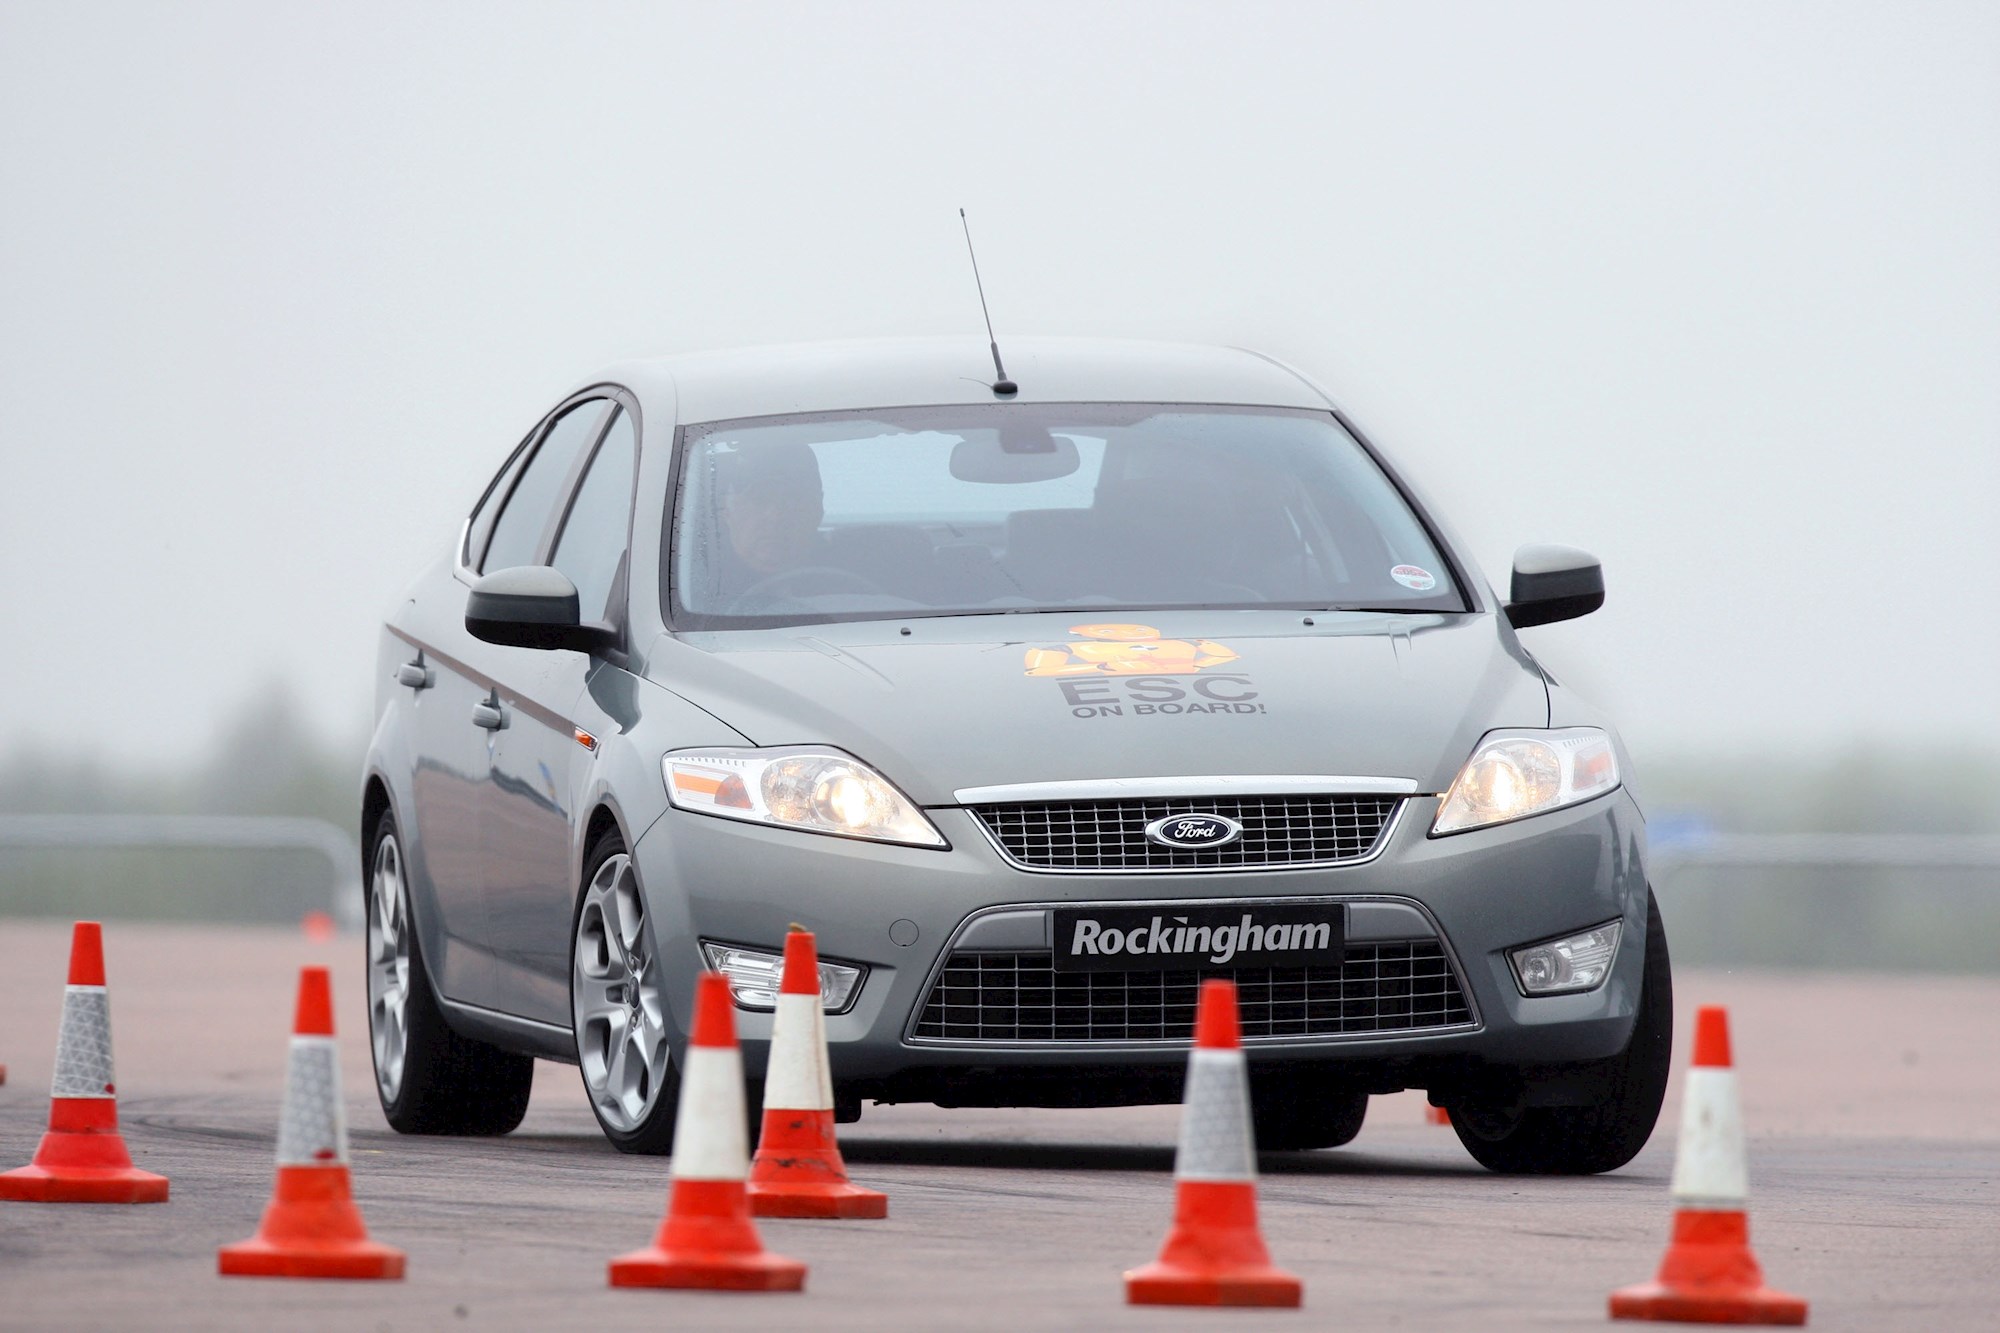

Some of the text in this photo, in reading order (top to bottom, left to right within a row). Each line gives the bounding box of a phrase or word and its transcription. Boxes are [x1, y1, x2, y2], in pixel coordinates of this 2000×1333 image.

[1057, 677, 1259, 705] ESC
[1072, 703, 1267, 719] ON BOARD!
[1174, 820, 1216, 838] Ford
[1070, 914, 1331, 964] Rockingham
